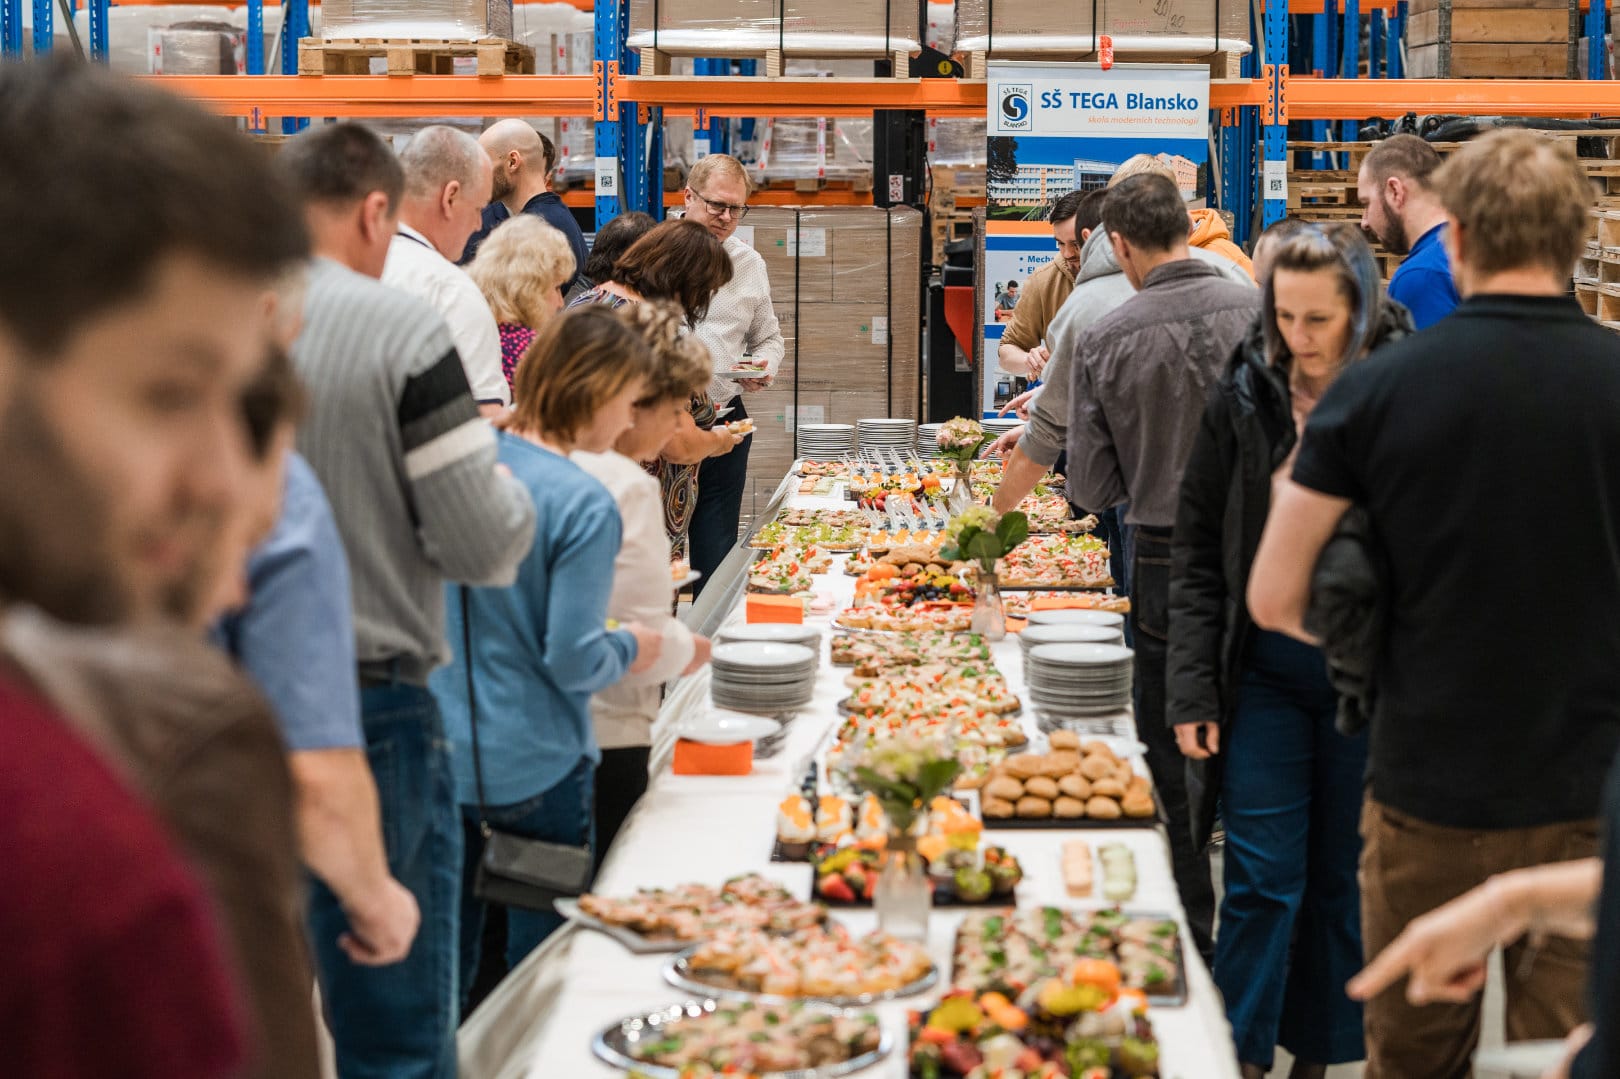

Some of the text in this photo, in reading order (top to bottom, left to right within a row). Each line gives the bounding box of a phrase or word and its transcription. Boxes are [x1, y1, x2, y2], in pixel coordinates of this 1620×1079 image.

[1012, 87, 1028, 95] TEGA
[1041, 89, 1199, 111] SŠ TEGA Blansko
[1003, 120, 1028, 128] BLANSKO
